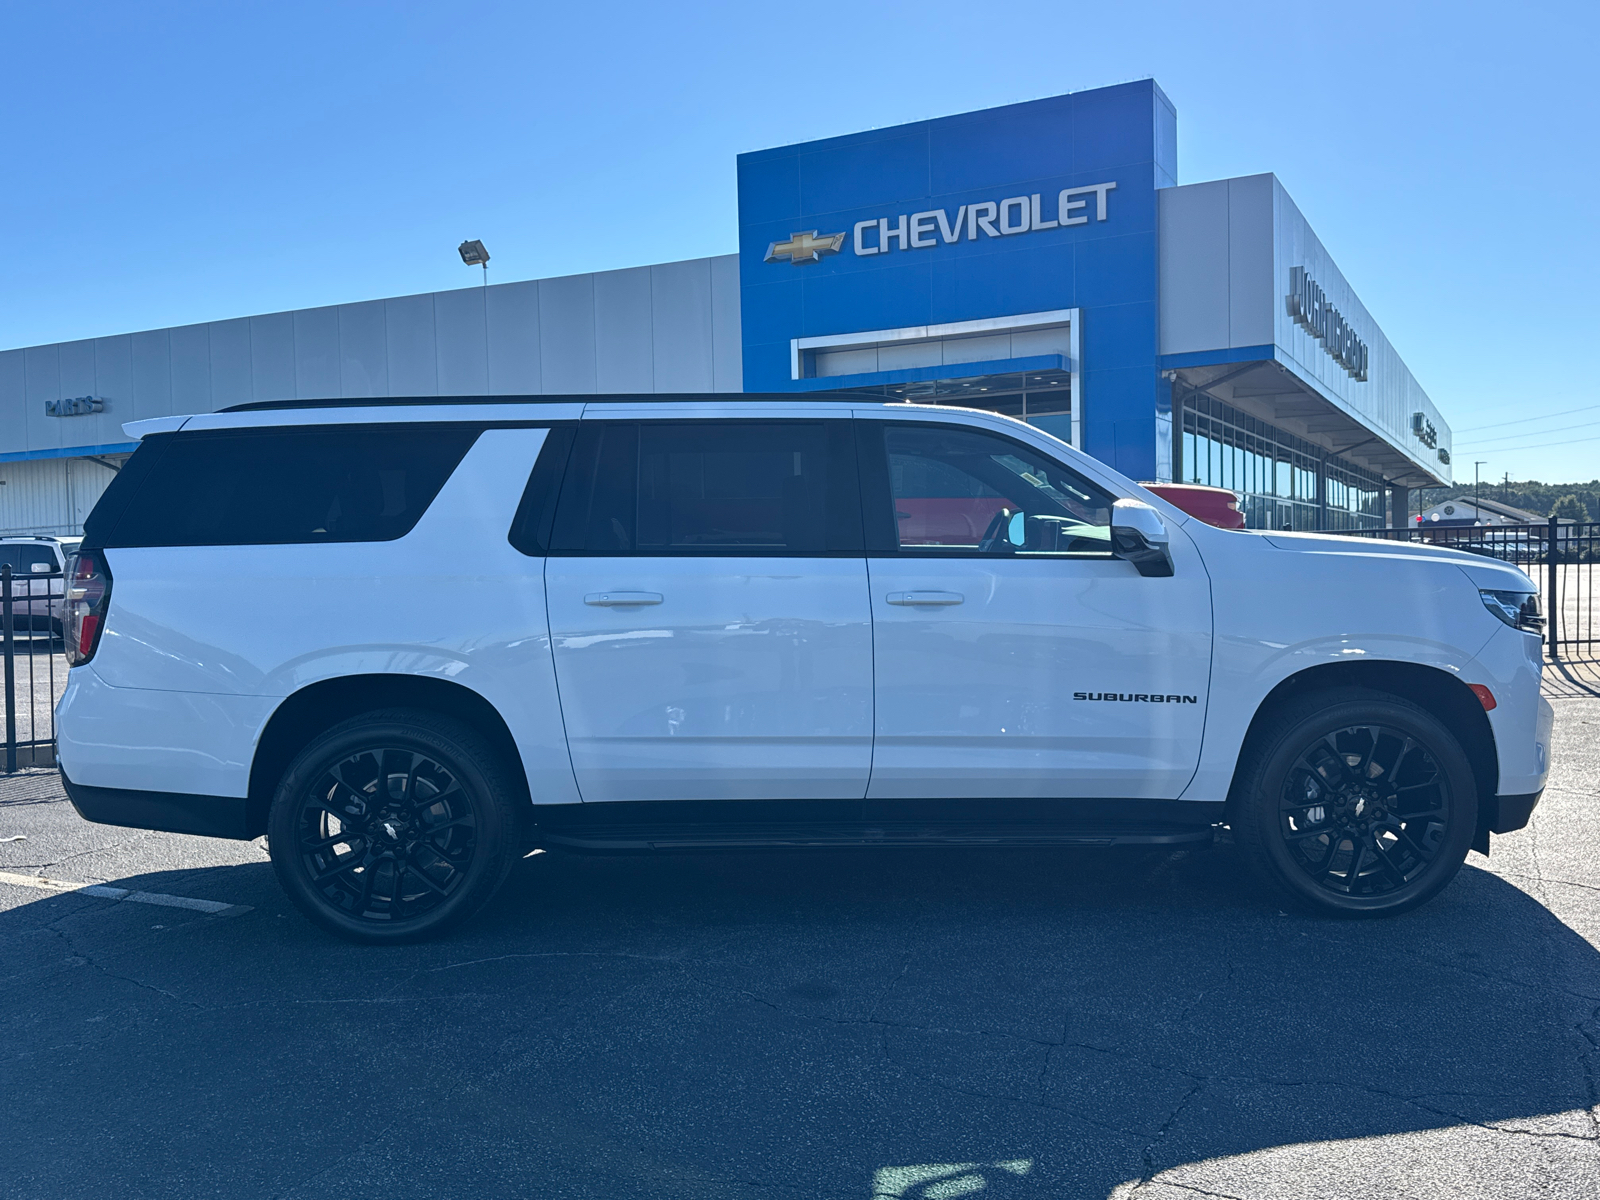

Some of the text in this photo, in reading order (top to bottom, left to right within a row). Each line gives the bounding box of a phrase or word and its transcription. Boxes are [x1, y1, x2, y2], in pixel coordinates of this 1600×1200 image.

[853, 181, 1117, 256] CHEVROLET
[1285, 265, 1326, 339] JOHN
[45, 395, 97, 416] PARTS
[1073, 692, 1197, 704] SUBURBAN
[400, 729, 463, 760] BRIDGESTONE
